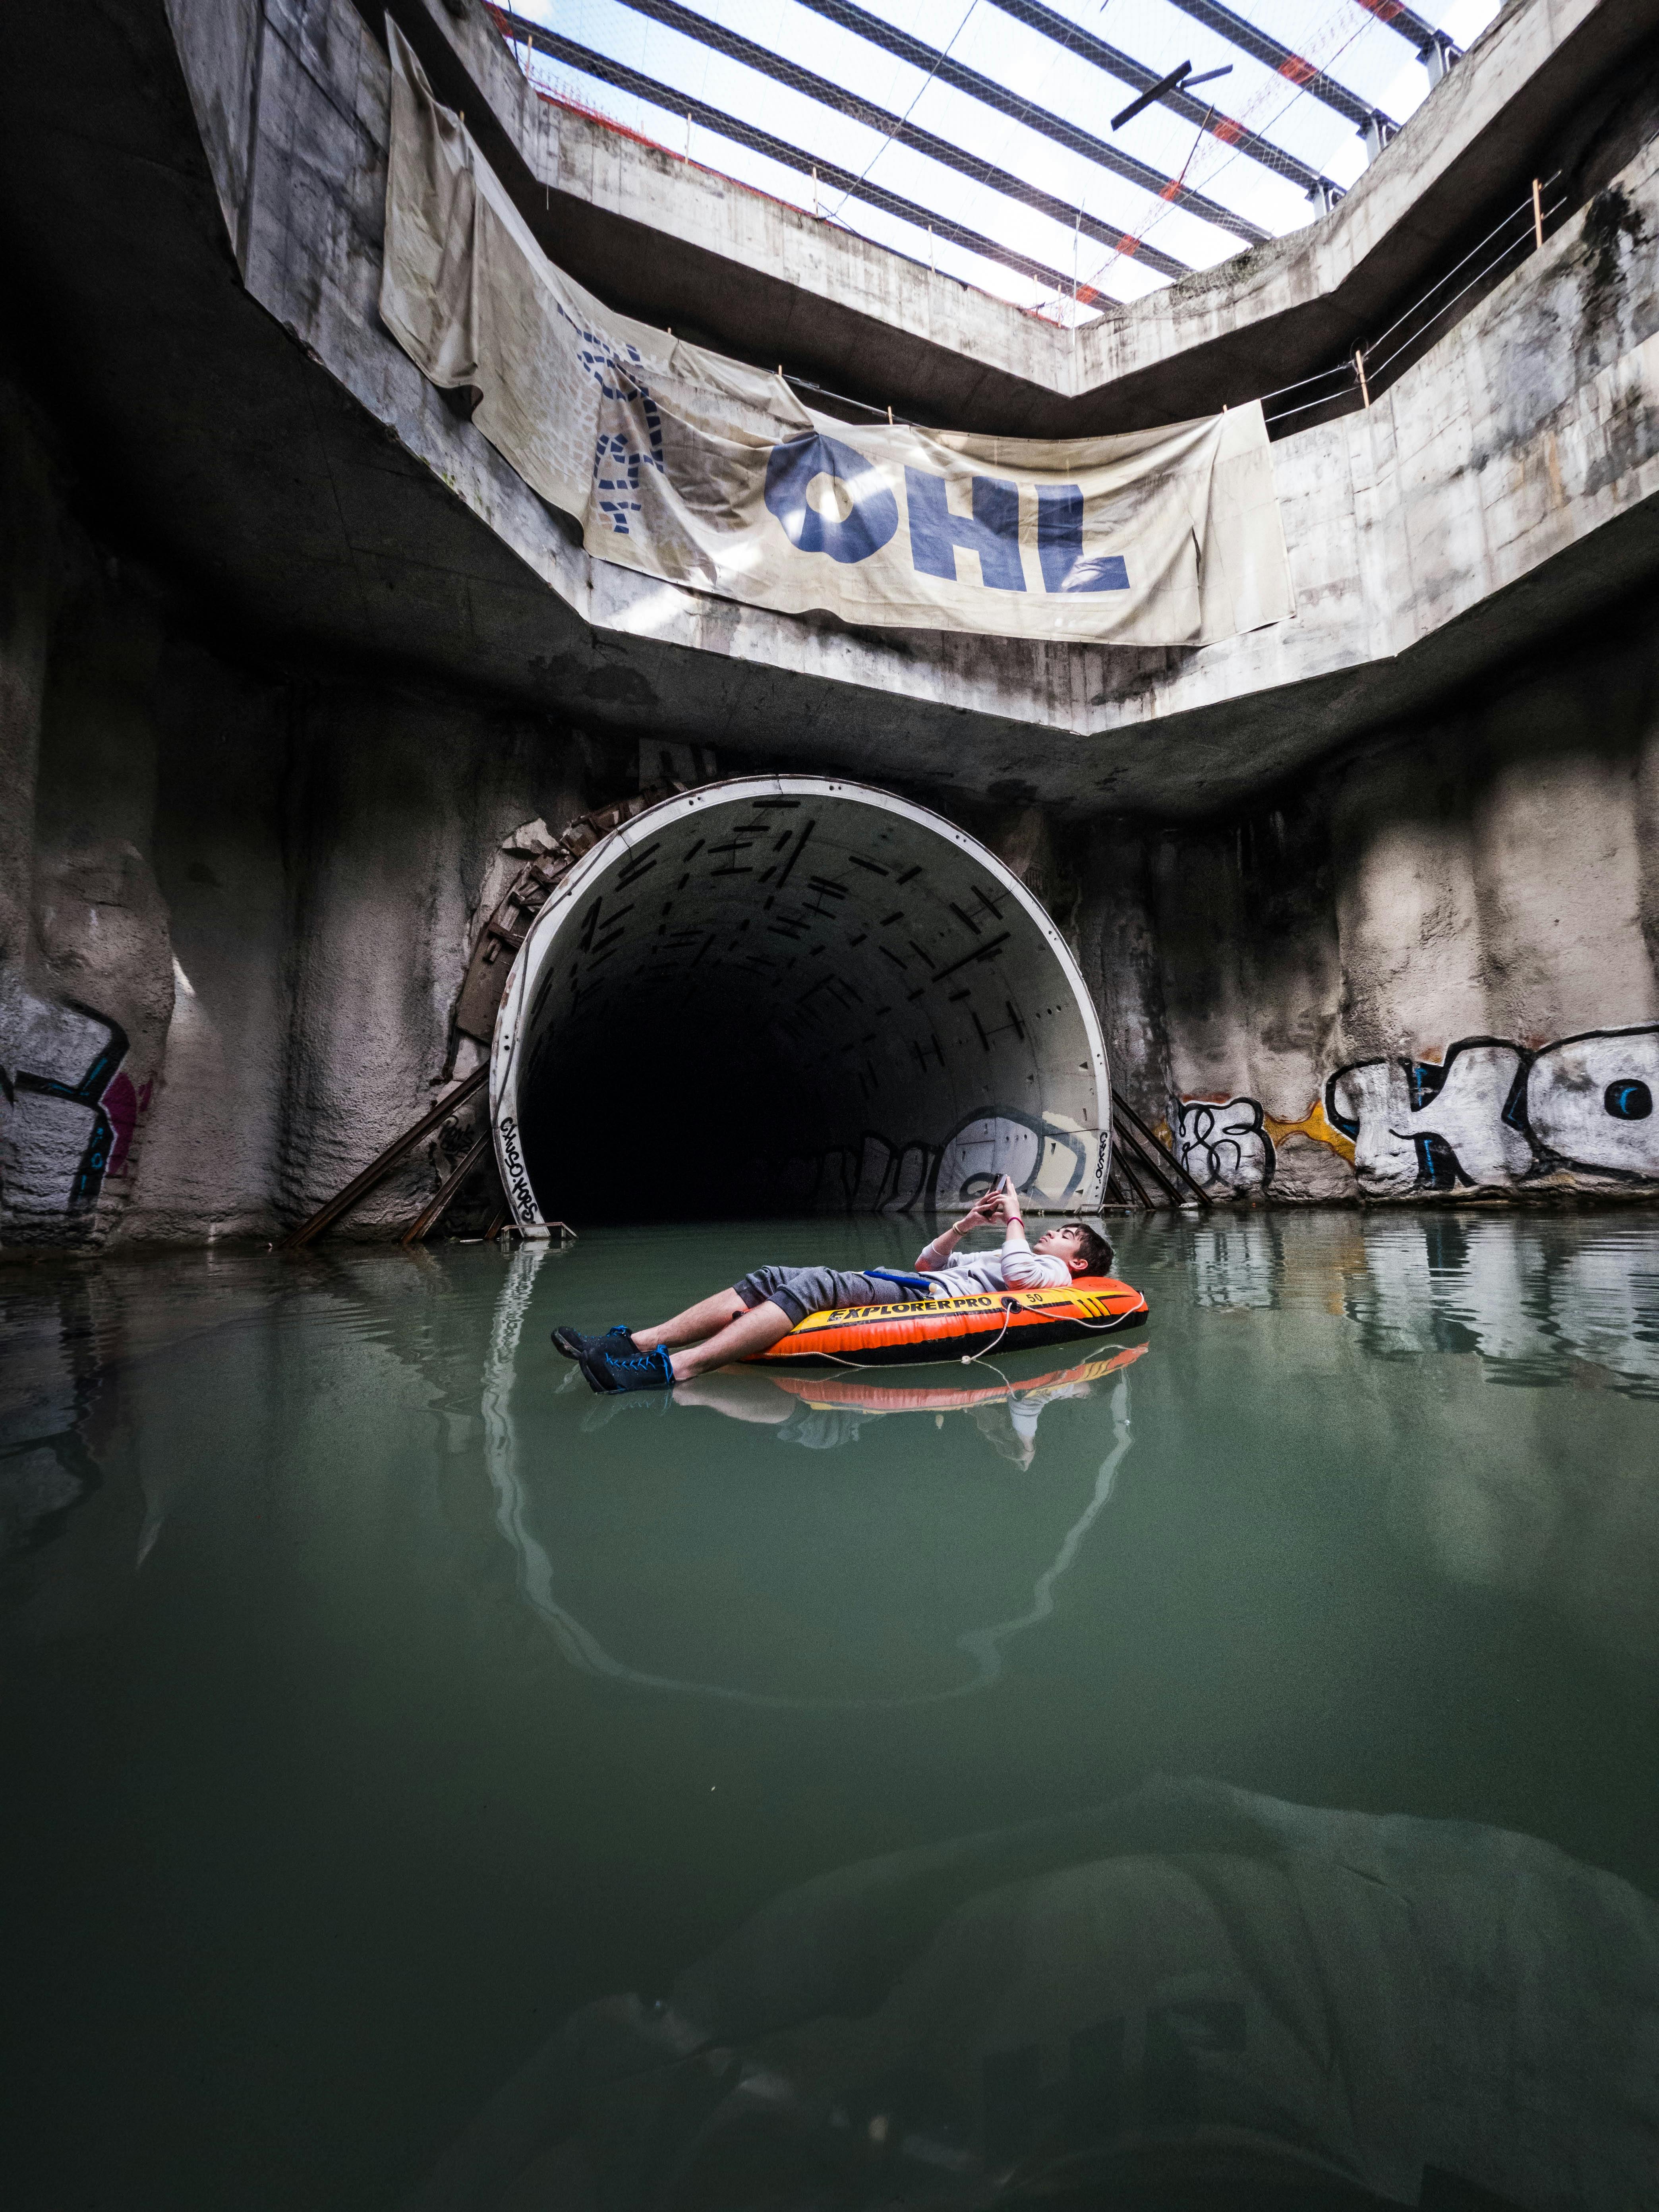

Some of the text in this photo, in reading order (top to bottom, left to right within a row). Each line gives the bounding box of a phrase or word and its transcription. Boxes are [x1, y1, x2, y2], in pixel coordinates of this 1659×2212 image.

[764, 433, 1131, 593] OHL
[827, 1293, 1043, 1322] EXPLORER PRO 50
